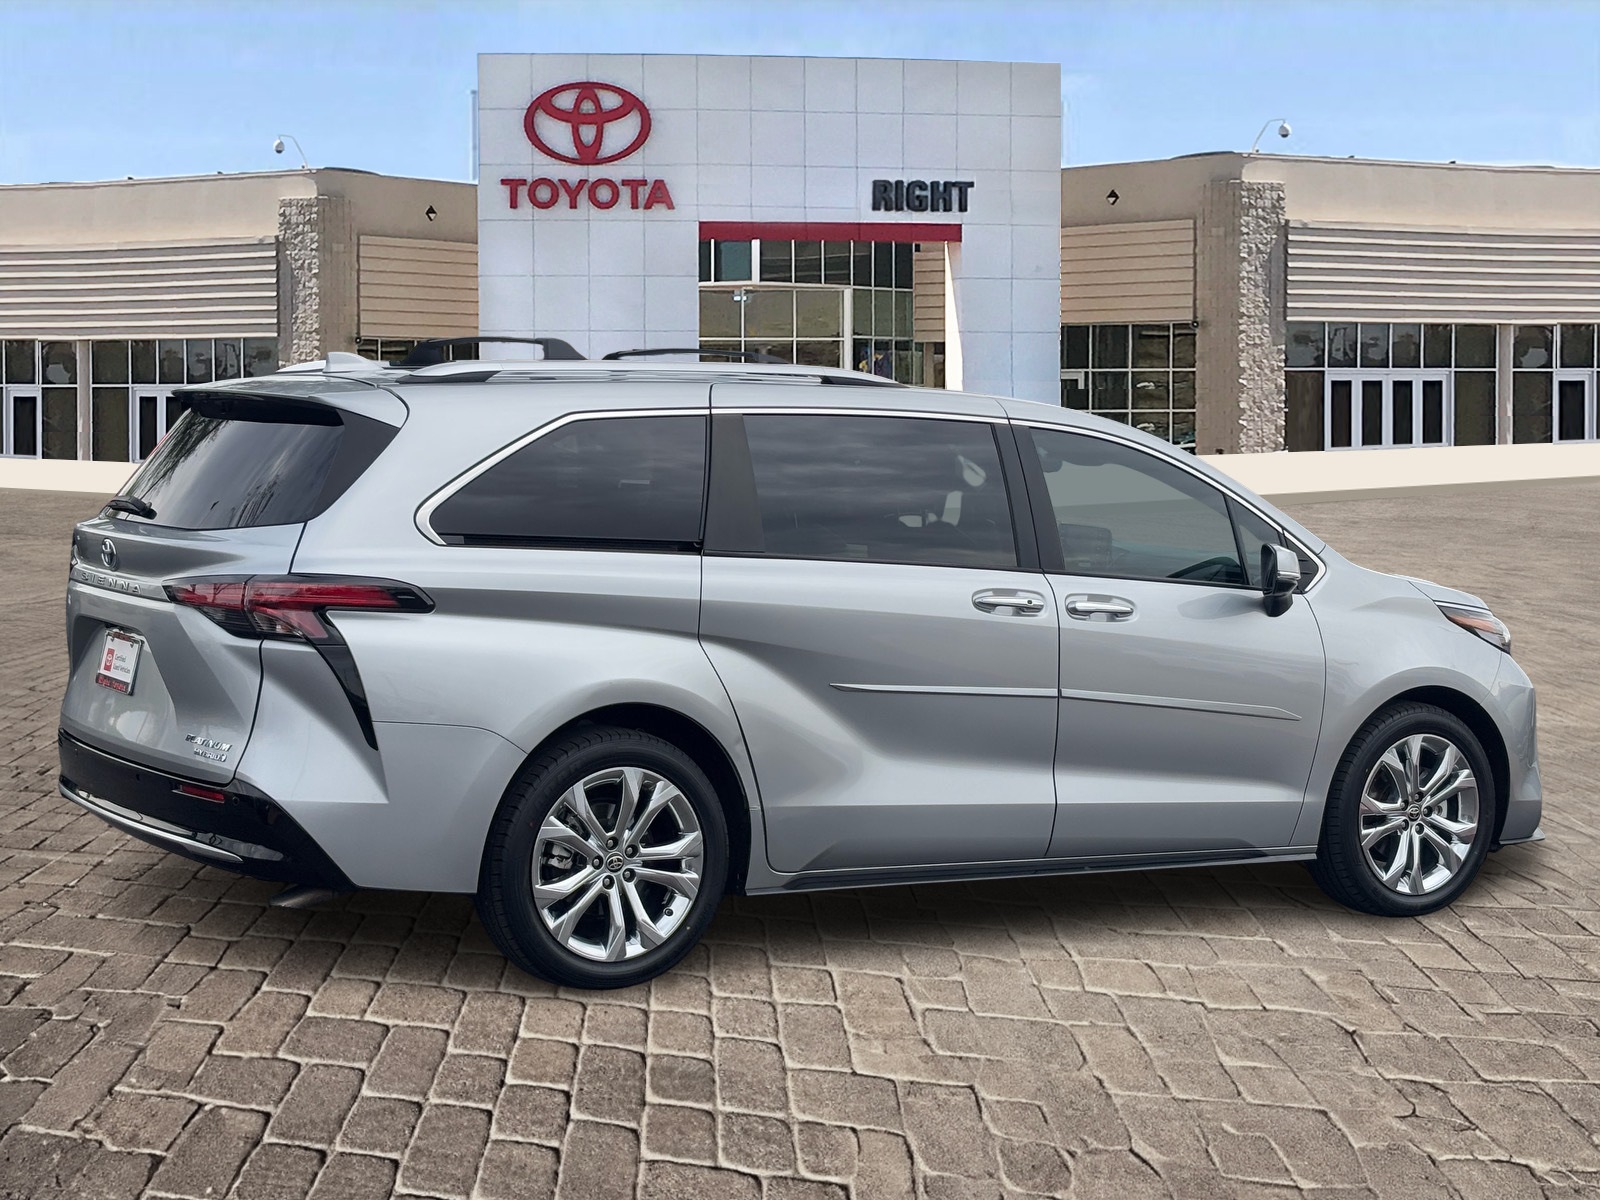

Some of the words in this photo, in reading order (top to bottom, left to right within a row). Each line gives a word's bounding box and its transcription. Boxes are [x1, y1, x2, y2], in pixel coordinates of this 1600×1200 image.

[500, 177, 675, 210] TOYOTA
[872, 179, 974, 212] RIGHT
[81, 572, 141, 594] SIENNA
[185, 733, 232, 752] PLATINUM
